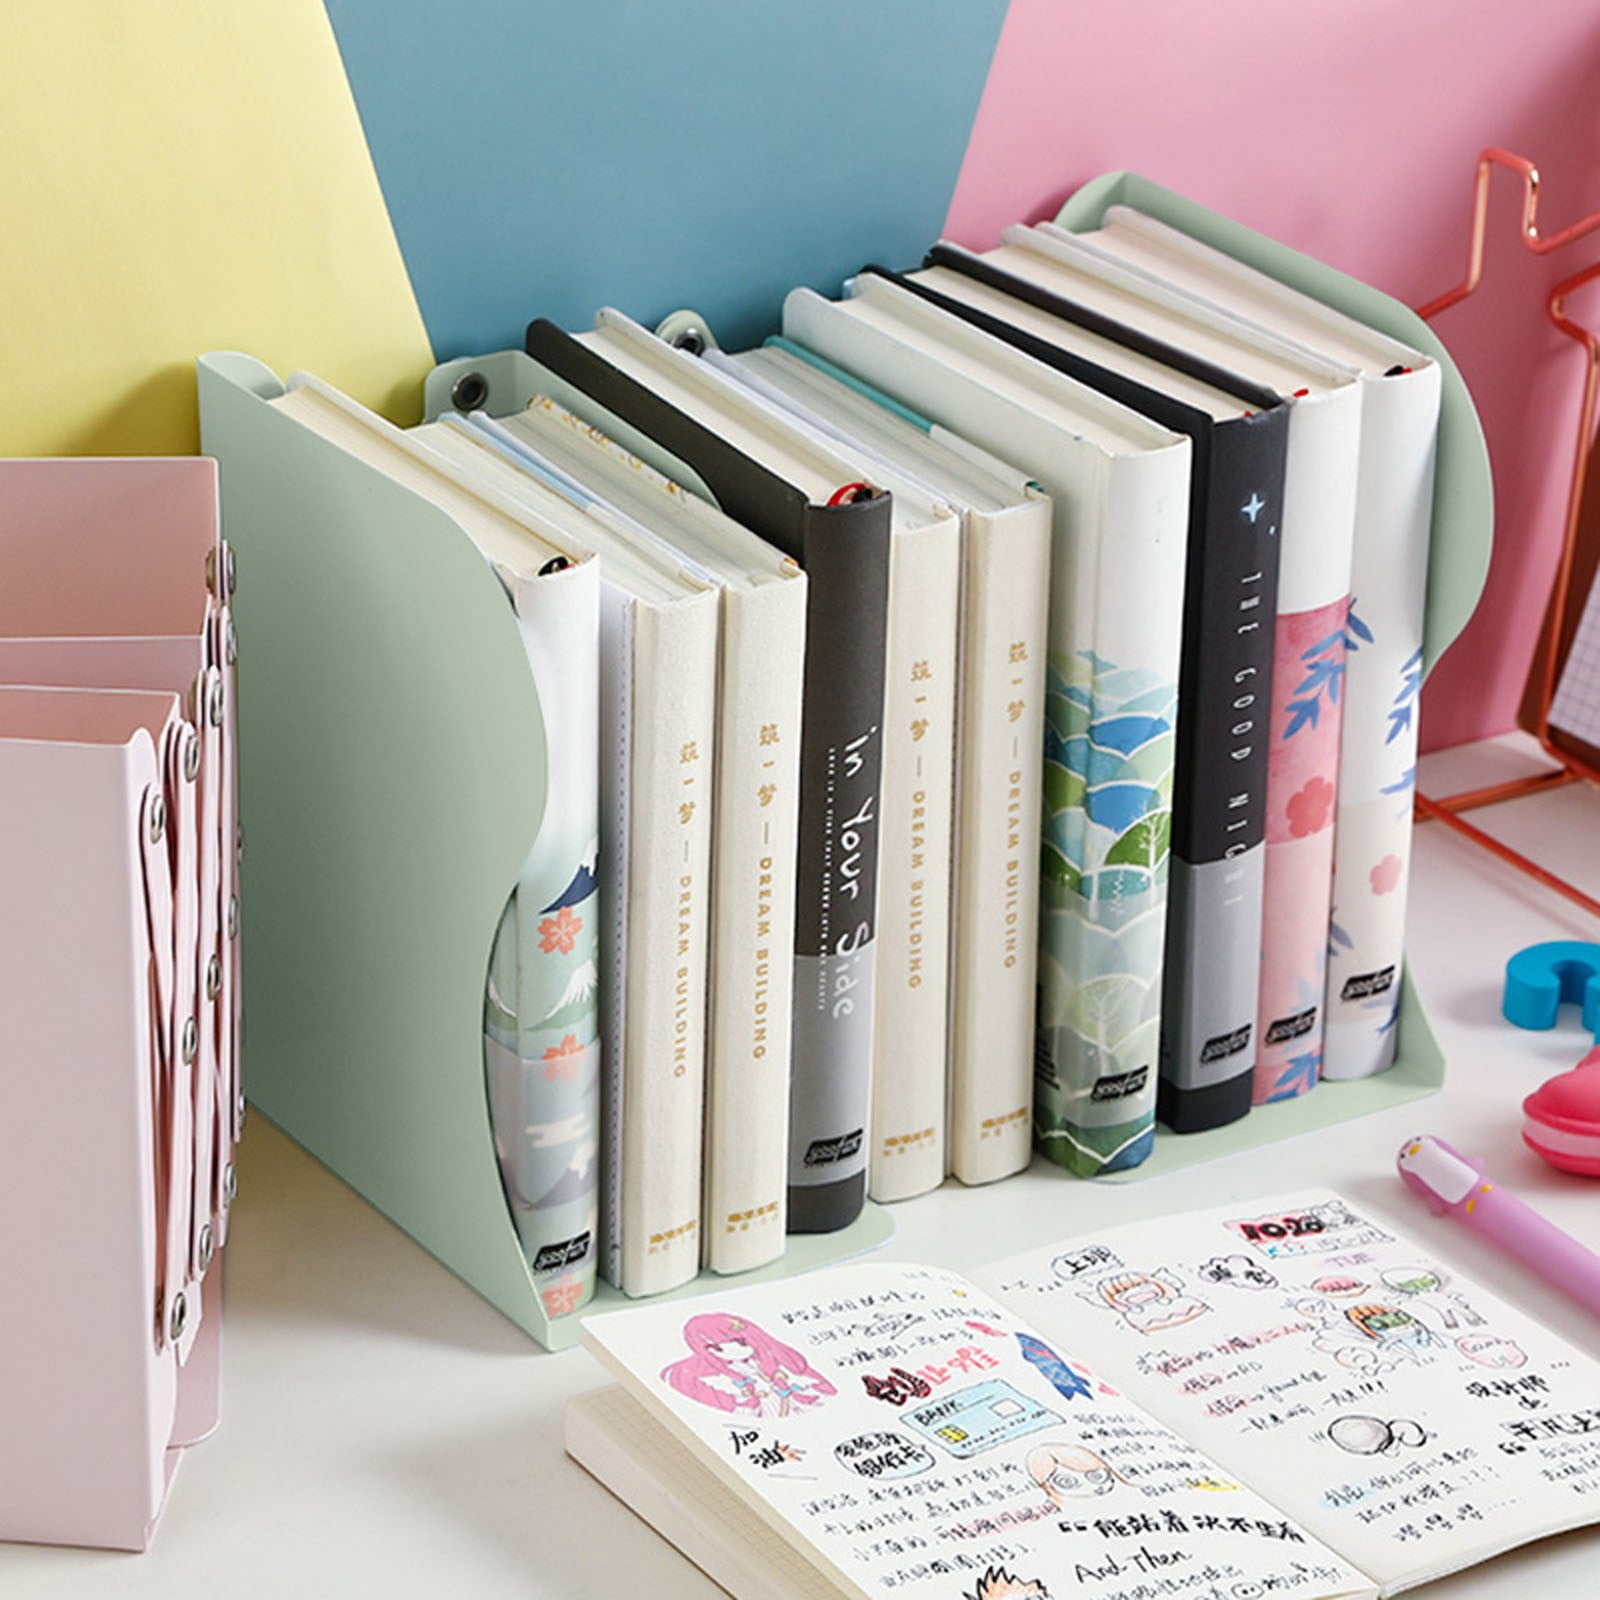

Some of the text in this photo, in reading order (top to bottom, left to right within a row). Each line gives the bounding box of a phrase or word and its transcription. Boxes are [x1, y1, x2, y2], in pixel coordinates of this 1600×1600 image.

[1231, 667, 1257, 761] GOOD
[839, 796, 874, 900] Your
[907, 791, 926, 990] DREAM BUILDING
[1003, 771, 1022, 969] DREAM BUILDING
[673, 875, 692, 1079] DREAM BUILDING
[752, 857, 773, 1060] DREAM BUILDING
[832, 921, 870, 1020] Side
